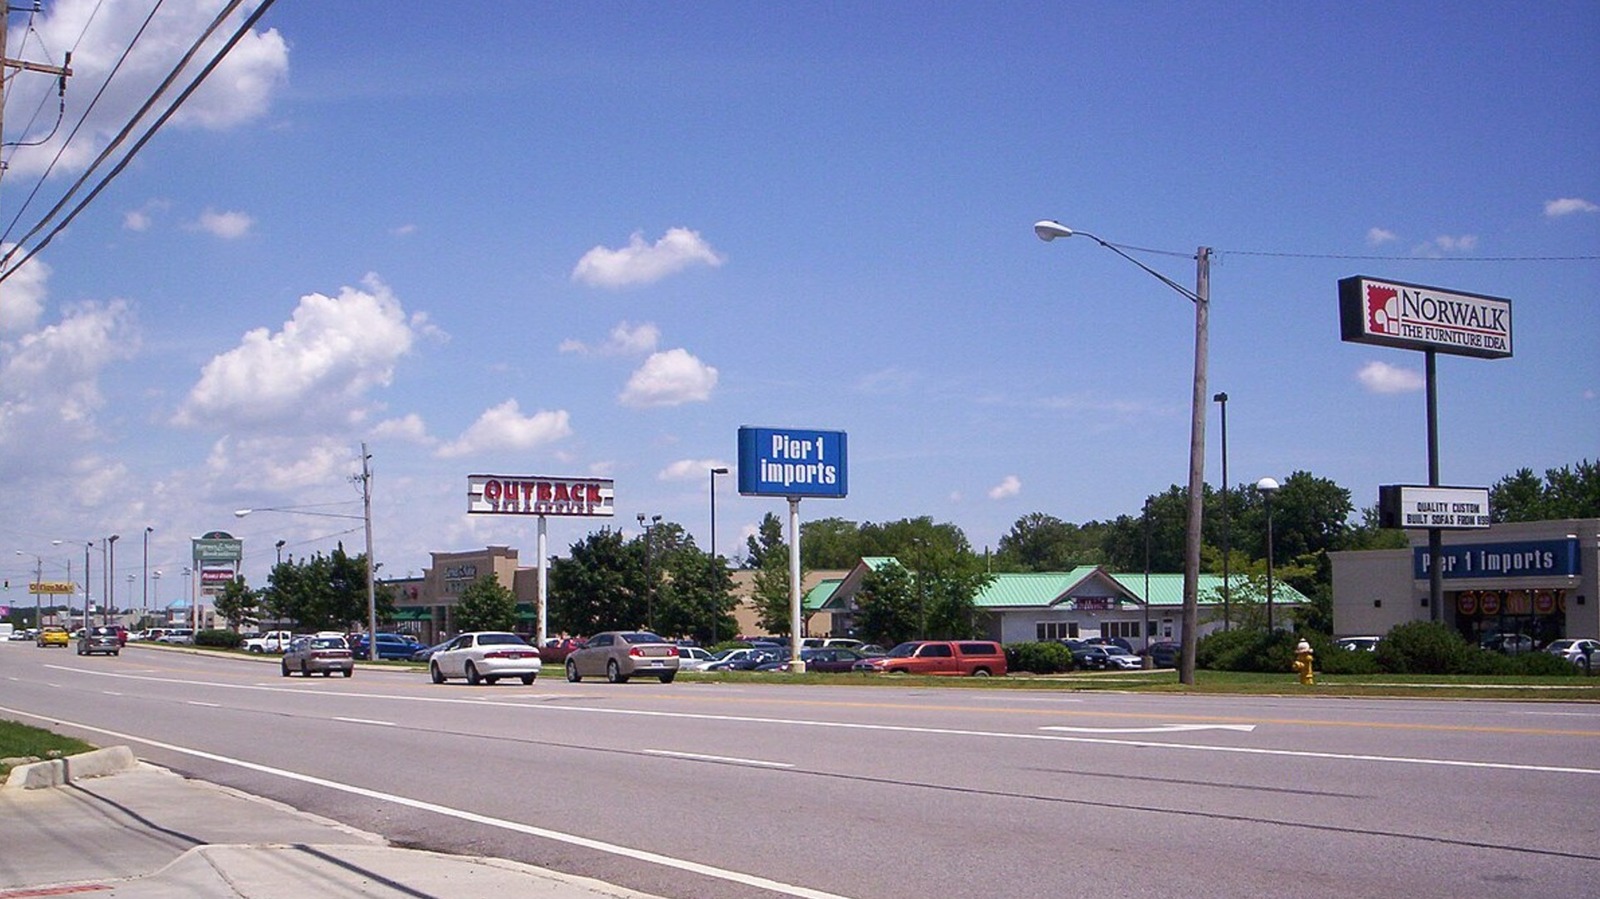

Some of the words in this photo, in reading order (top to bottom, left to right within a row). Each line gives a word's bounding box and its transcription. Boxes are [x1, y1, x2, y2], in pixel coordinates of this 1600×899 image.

[1401, 289, 1506, 333] NORWALK
[1401, 323, 1423, 338] THE
[1425, 327, 1482, 346] FURNITURE
[1484, 339, 1507, 350] IDEA
[772, 434, 812, 459] Pier
[816, 436, 824, 460] 1
[760, 458, 836, 487] imports
[484, 479, 602, 504] OUTBACK
[1417, 502, 1448, 513] QUALITY
[1452, 503, 1480, 514] CUSTOM
[1431, 514, 1454, 525] SOFAS
[1457, 515, 1476, 525] FROM
[1422, 552, 1456, 573] Per
[1465, 551, 1472, 571] 1
[1480, 549, 1554, 573] imports
